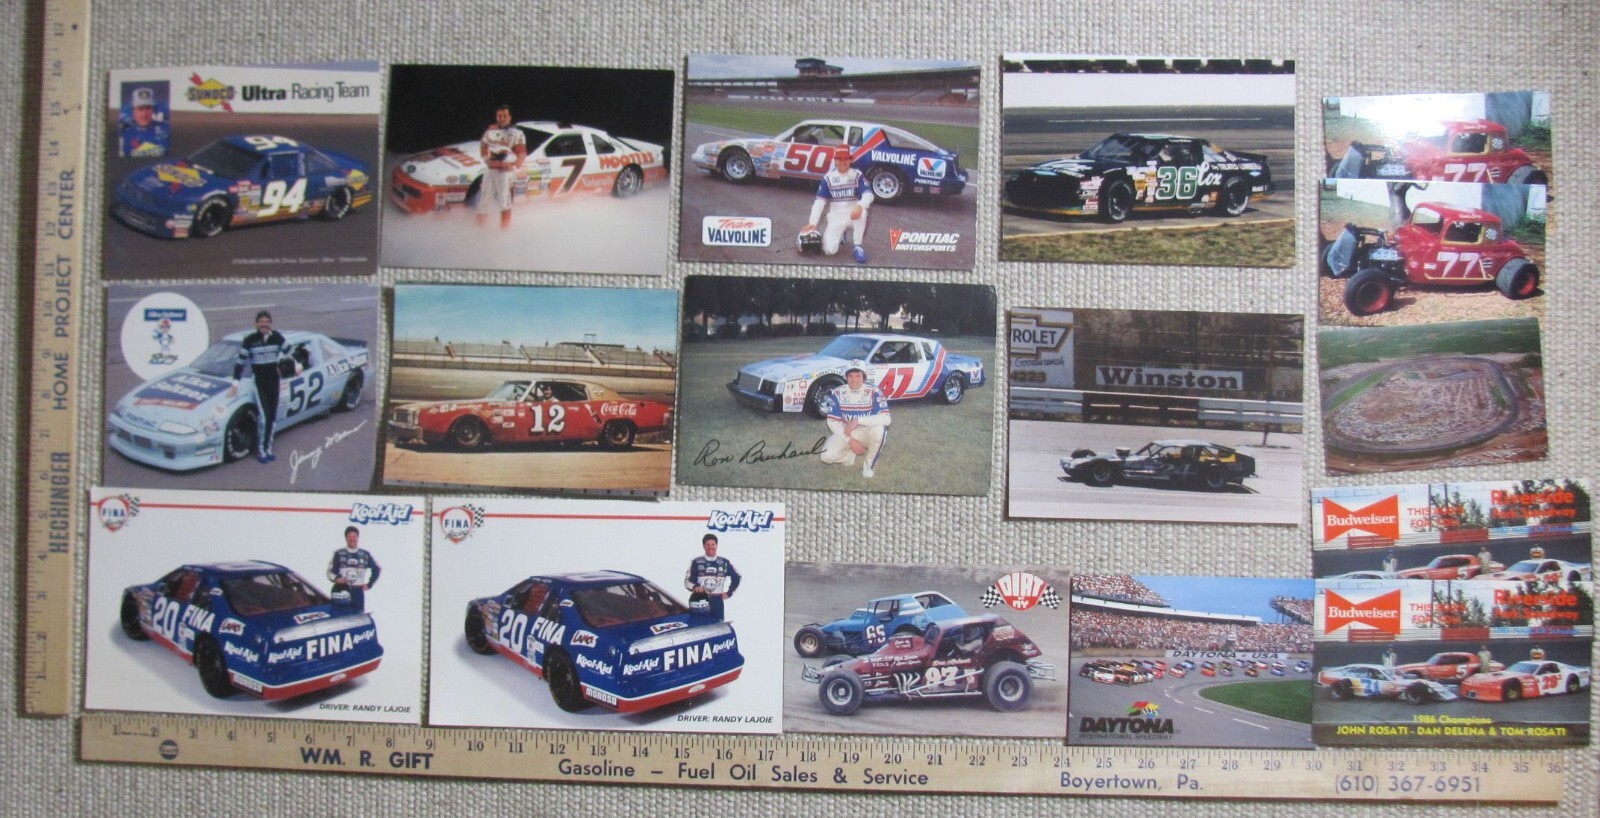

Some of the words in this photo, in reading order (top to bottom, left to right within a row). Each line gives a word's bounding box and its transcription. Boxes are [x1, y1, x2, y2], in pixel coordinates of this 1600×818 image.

[187, 86, 236, 101] SUNOCO
[242, 85, 287, 101] Ultra
[291, 82, 334, 102] Racing
[335, 81, 370, 99] Team
[49, 140, 59, 157] 14
[599, 152, 655, 169] HOOTERS
[784, 143, 835, 174] 50
[871, 150, 916, 166] VALVOLINE
[557, 157, 587, 195] 7
[1444, 163, 1487, 182] 77
[914, 178, 940, 186] PONTIAC
[1155, 166, 1199, 200] 36
[257, 178, 308, 217] 94
[58, 169, 75, 240] CENTER
[718, 218, 756, 230] Team
[708, 227, 767, 244] VALVOLINE
[899, 232, 960, 244] PONTIAC
[895, 243, 957, 252] MOTORSPORTS
[1437, 251, 1480, 278] 77
[55, 254, 71, 338] PROJECT
[53, 352, 69, 410] HOME
[878, 367, 915, 399] 47
[1098, 365, 1239, 390] Winston
[286, 371, 324, 418] 52
[530, 404, 565, 434] 12
[49, 452, 70, 552] HECHINGER
[1490, 489, 1575, 505] Riverside
[102, 508, 125, 518] FINA
[349, 502, 414, 525] Kool-Aid
[1406, 507, 1430, 516] THIS
[444, 519, 469, 528] FINA
[707, 510, 774, 532] Kool-Aid
[1327, 514, 1396, 527] Budweiser
[1410, 519, 1431, 528] FOR
[997, 572, 1044, 596] DIRT
[1493, 589, 1577, 606] Riverside
[1409, 603, 1433, 611] THIS
[182, 604, 215, 632] FINA
[1328, 607, 1397, 619] Budweiser
[153, 597, 181, 641] 20
[1412, 615, 1433, 624] FOR
[38, 632, 46, 640] 2
[500, 609, 528, 654] 20
[531, 616, 566, 645] FINA
[306, 633, 354, 660] FINA
[712, 637, 735, 654] Kool-Aid
[224, 641, 259, 663] Kool-Aid
[268, 647, 302, 663] Kool-Aid
[663, 642, 713, 672] FINA
[1172, 650, 1236, 659] DAYTONA
[1252, 651, 1279, 659] USA
[576, 653, 612, 675] Kool-Aid
[623, 657, 659, 676] Kool-Aid
[1456, 664, 1468, 679] 5
[319, 703, 350, 711] DRIVER:
[678, 715, 710, 723] DRIVER:
[712, 715, 743, 724] RANDY
[745, 716, 774, 724] LAJOIE
[1413, 715, 1436, 723] 1986
[1439, 714, 1493, 726] Champions
[113, 725, 119, 735] 1
[1079, 717, 1175, 734] DAYTONA
[1337, 725, 1366, 735] JOHN
[1369, 726, 1408, 735] ROSATI
[1417, 727, 1441, 735] DAN
[1444, 727, 1485, 735] DELENA
[1489, 727, 1497, 736] &
[1500, 727, 1524, 736] TOM
[1527, 728, 1567, 736] ROSATI
[150, 727, 157, 737] 2
[189, 729, 196, 739] 3
[227, 731, 234, 741] 4
[267, 732, 273, 743] 5
[305, 733, 312, 744] 6
[346, 736, 352, 746] 7
[385, 738, 393, 748] 8
[425, 739, 433, 750] 9
[467, 741, 484, 751] 10
[508, 742, 523, 753] 11
[550, 744, 565, 754] 12
[591, 745, 606, 756] 13
[632, 746, 649, 757] 14
[674, 748, 690, 759] 15
[716, 749, 733, 760] 16
[758, 750, 775, 761] 17
[300, 747, 345, 766] WM.
[360, 750, 375, 767] R.
[389, 751, 434, 770] GIFT
[800, 751, 817, 762] 18
[842, 752, 859, 763] 19
[884, 754, 901, 764] 20
[926, 755, 942, 765] 21
[969, 755, 985, 766] 22
[1011, 756, 1028, 767] 23
[1053, 757, 1070, 768] 24
[1095, 758, 1112, 768] 25
[1137, 758, 1155, 769] 26
[1180, 759, 1196, 770] 27
[1222, 759, 1239, 770] 28
[1263, 760, 1281, 771] 29
[1305, 760, 1323, 771] 30
[1347, 760, 1363, 771] 31
[1388, 760, 1405, 771] 32
[1429, 761, 1446, 772] 33
[1471, 761, 1488, 772] 34
[1513, 762, 1529, 773] 35
[1547, 762, 1562, 773] 36
[558, 759, 635, 777] Gasoline
[678, 762, 715, 779] Fuel
[729, 763, 756, 781] Oil
[771, 764, 818, 783] Sales
[833, 767, 848, 784] &
[863, 767, 929, 785] Service
[1060, 771, 1162, 792] Boyertown,
[1177, 773, 1203, 791] Pa.
[1335, 775, 1379, 794] (610)
[1388, 776, 1480, 793] 367-6951
